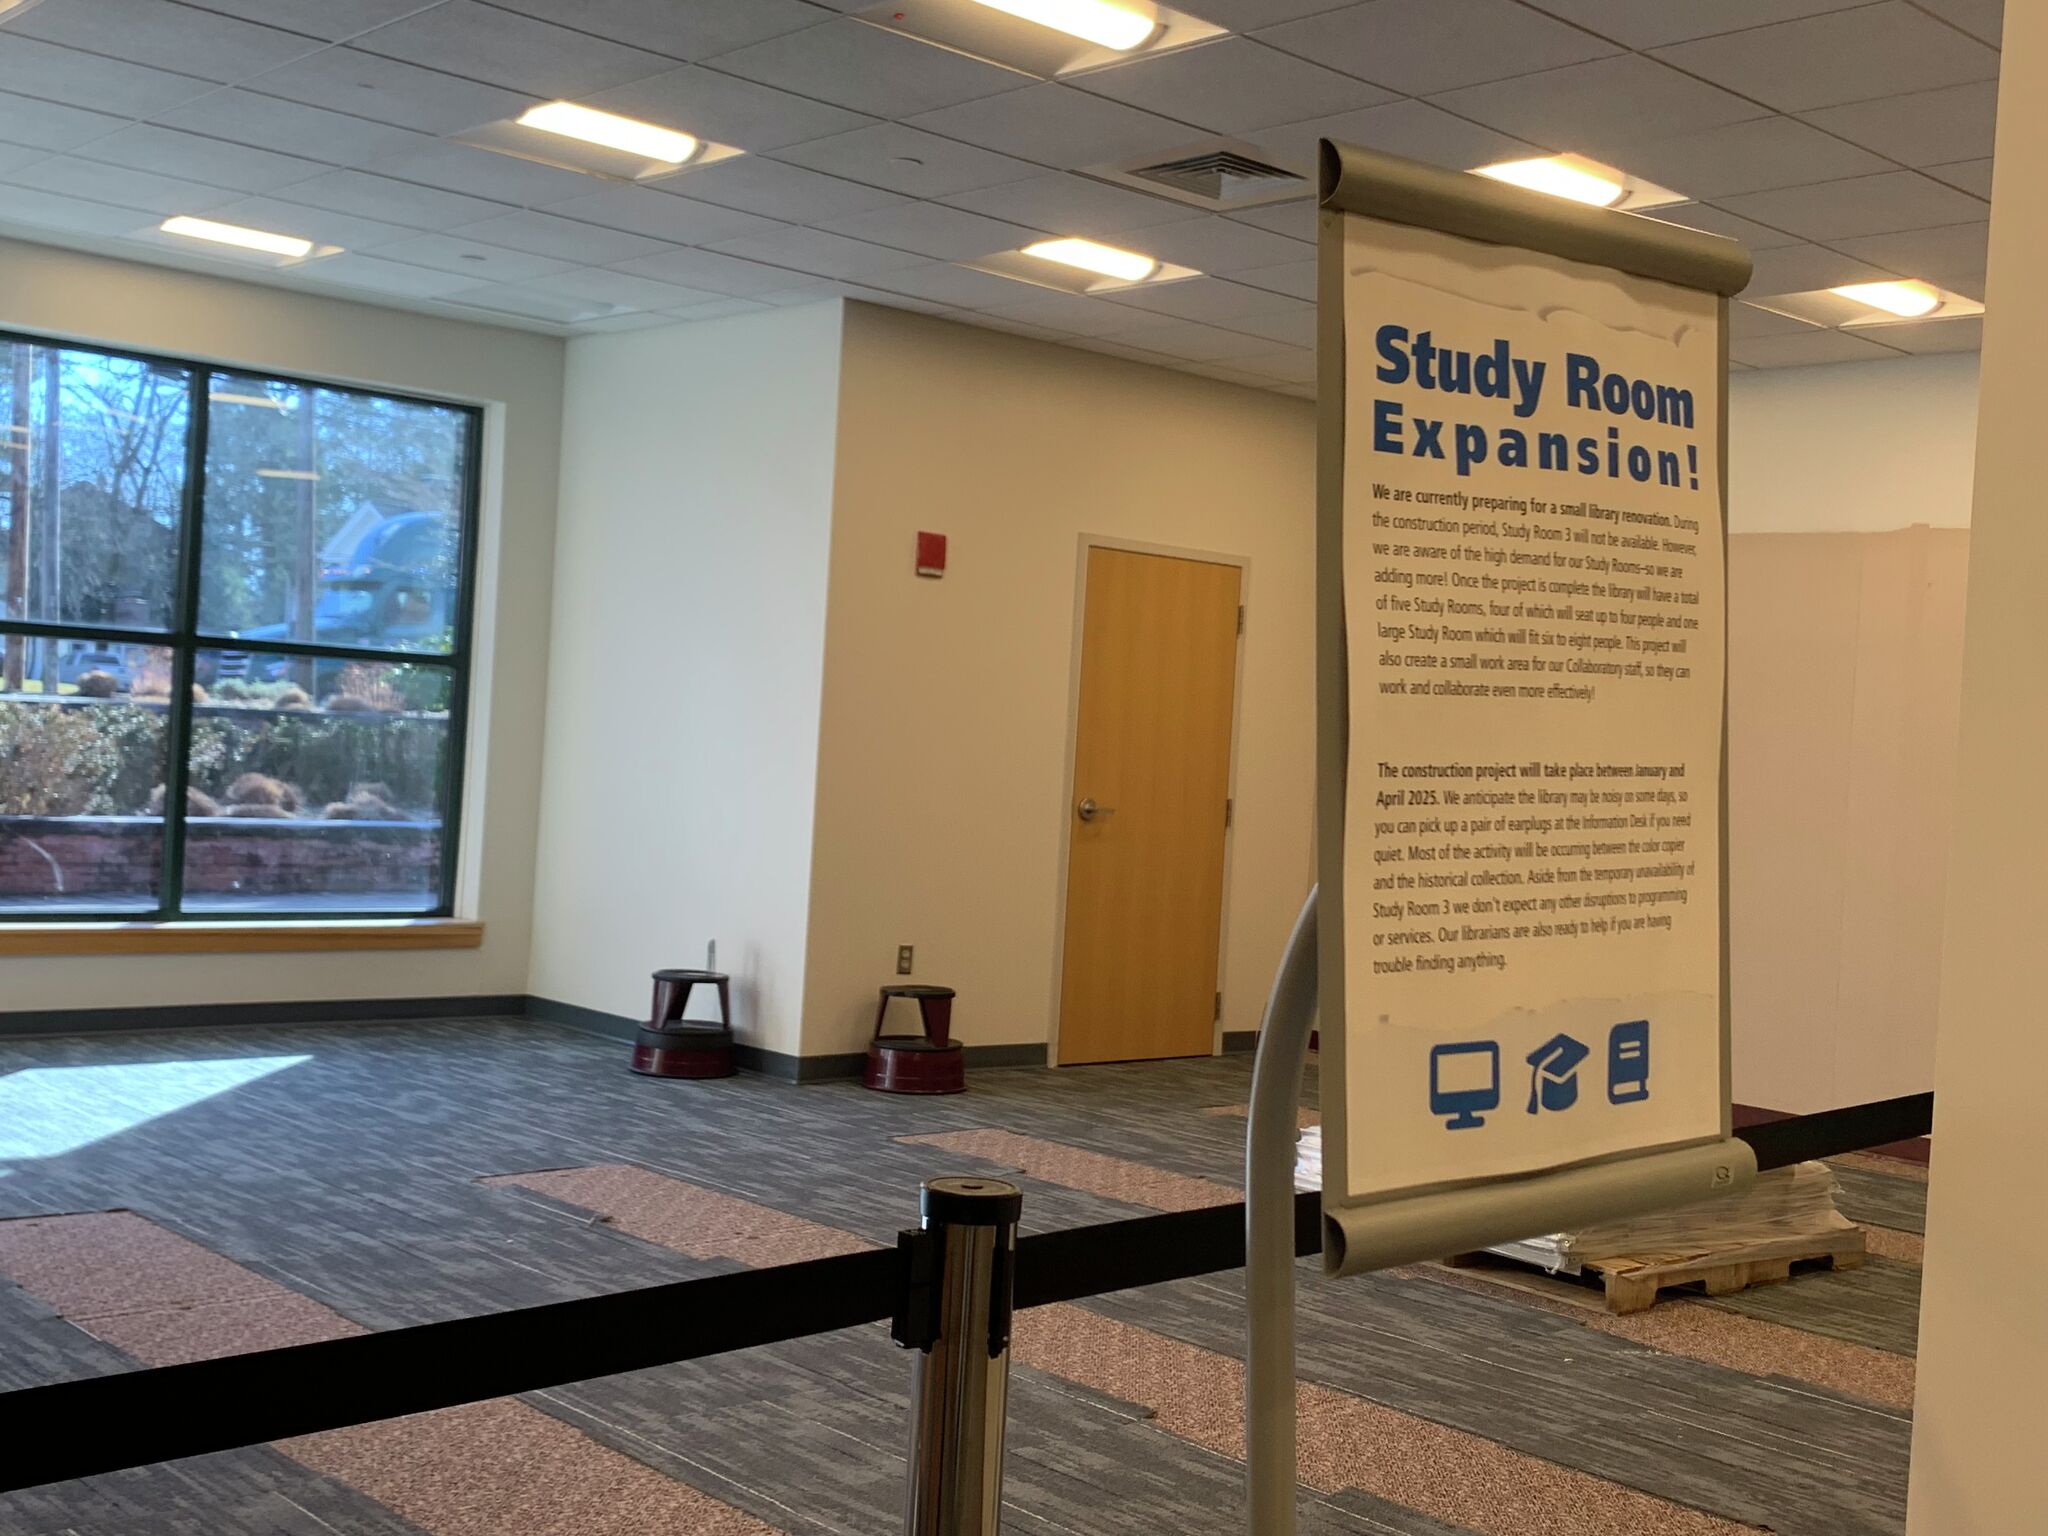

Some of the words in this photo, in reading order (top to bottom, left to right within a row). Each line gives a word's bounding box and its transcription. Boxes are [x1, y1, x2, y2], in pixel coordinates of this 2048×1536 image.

[1374, 324, 1547, 418] Study
[1566, 352, 1695, 429] Room
[1373, 399, 1699, 491] Expansion!
[1373, 483, 1390, 500] We
[1394, 489, 1412, 502] are
[1416, 490, 1468, 511] currently
[1472, 495, 1527, 516] preparing
[1530, 497, 1546, 514] for
[1550, 503, 1557, 514] a
[1560, 502, 1586, 518] small
[1589, 503, 1620, 525] library
[1674, 515, 1699, 535] During
[1373, 511, 1389, 528] the
[1393, 517, 1459, 534] construction
[1463, 520, 1498, 538] period,
[1502, 522, 1531, 542] Study
[1533, 524, 1562, 541] Room
[1565, 527, 1571, 542] 3
[1573, 528, 1588, 544] will
[1591, 532, 1606, 547] not
[1608, 531, 1619, 547] be
[1373, 543, 1389, 555] we
[1393, 544, 1409, 558] are
[1413, 546, 1447, 559] aware
[1451, 544, 1462, 560] of
[1464, 546, 1481, 561] the
[1484, 546, 1507, 567] high
[1510, 549, 1550, 566] demand
[1553, 551, 1566, 567] for
[1569, 557, 1583, 569] our
[1585, 555, 1610, 575] Study
[1656, 566, 1668, 577] we
[1670, 567, 1683, 579] are
[1375, 566, 1413, 588] adding
[1416, 571, 1447, 588] more!
[1452, 572, 1479, 588] Once
[1482, 573, 1499, 589] the
[1501, 576, 1536, 595] project
[1538, 577, 1546, 592] is
[1549, 580, 1589, 598] complete
[1592, 582, 1606, 597] the
[1608, 583, 1634, 603] library
[1652, 587, 1671, 602] have
[1376, 594, 1388, 610] of
[1391, 594, 1411, 613] five
[1414, 597, 1444, 617] Study
[1448, 599, 1486, 617] Rooms,
[1490, 600, 1509, 616] four
[1513, 602, 1524, 617] of
[1526, 603, 1554, 619] which
[1556, 605, 1573, 620] will
[1575, 608, 1593, 622] seat
[1596, 612, 1607, 627] up
[1609, 611, 1618, 623] to
[1620, 609, 1636, 625] four
[1638, 612, 1664, 632] people
[1666, 614, 1681, 630] and
[1683, 618, 1698, 630] one
[1378, 621, 1405, 643] large
[1409, 624, 1439, 644] Study
[1442, 625, 1472, 642] Room
[1475, 627, 1505, 643] which
[1507, 629, 1526, 644] will
[1528, 629, 1539, 646] fit
[1541, 631, 1554, 645] six
[1556, 632, 1566, 646] to
[1569, 632, 1591, 651] eight
[1626, 636, 1641, 651] This
[1379, 650, 1401, 667] also
[1405, 654, 1437, 669] create
[1440, 657, 1447, 668] a
[1450, 653, 1477, 670] small
[1480, 655, 1504, 670] work
[1507, 659, 1529, 671] area
[1532, 655, 1546, 671] for
[1549, 661, 1563, 672] our
[1566, 658, 1622, 679] Collaboratory
[1645, 666, 1654, 677] so
[1657, 663, 1674, 682] they
[1676, 667, 1690, 679] can
[1379, 678, 1406, 694] work
[1410, 679, 1430, 695] and
[1433, 680, 1490, 697] collaborate
[1492, 686, 1516, 697] even
[1518, 686, 1544, 698] more
[1378, 761, 1399, 778] The
[1402, 762, 1473, 779] construction
[1476, 762, 1516, 782] project
[1519, 762, 1540, 779] will
[1544, 762, 1567, 778] take
[1569, 762, 1594, 782] place
[1596, 762, 1633, 777] between
[1635, 763, 1667, 781] January
[1669, 762, 1685, 777] and
[1376, 789, 1404, 810] April
[1408, 790, 1439, 806] 2025.
[1443, 790, 1459, 805] We
[1463, 789, 1515, 808] anticipate
[1518, 789, 1534, 804] the
[1538, 788, 1567, 808] library
[1375, 822, 1394, 839] you
[1397, 822, 1416, 834] can
[1419, 816, 1441, 837] pick
[1444, 821, 1457, 836] up
[1461, 819, 1467, 832] a
[1471, 816, 1492, 836] pair
[1494, 815, 1506, 832] of
[1508, 815, 1552, 835] earplugs
[1374, 846, 1404, 866] quiet.
[1408, 845, 1436, 862] Most
[1438, 843, 1450, 861] of
[1452, 844, 1470, 860] the
[1473, 843, 1511, 863] activity
[1514, 841, 1533, 858] will
[1536, 841, 1548, 857] be
[1373, 873, 1394, 890] and
[1397, 873, 1414, 889] the
[1418, 870, 1468, 888] historical
[1471, 869, 1524, 886] collection.
[1527, 868, 1554, 884] Aside
[1373, 900, 1404, 922] Study
[1407, 900, 1440, 918] Room
[1443, 899, 1449, 915] 3
[1453, 902, 1469, 915] we
[1472, 896, 1500, 913] don't
[1502, 897, 1537, 916] expect
[1539, 898, 1556, 914] any
[1373, 933, 1384, 947] or
[1387, 928, 1435, 946] services.
[1438, 927, 1458, 943] Our
[1461, 924, 1510, 942] librarians
[1513, 926, 1530, 938] are
[1533, 921, 1552, 937] also
[1373, 956, 1413, 975] trouble
[1416, 953, 1454, 974] finding
[1457, 951, 1507, 972] anything.
